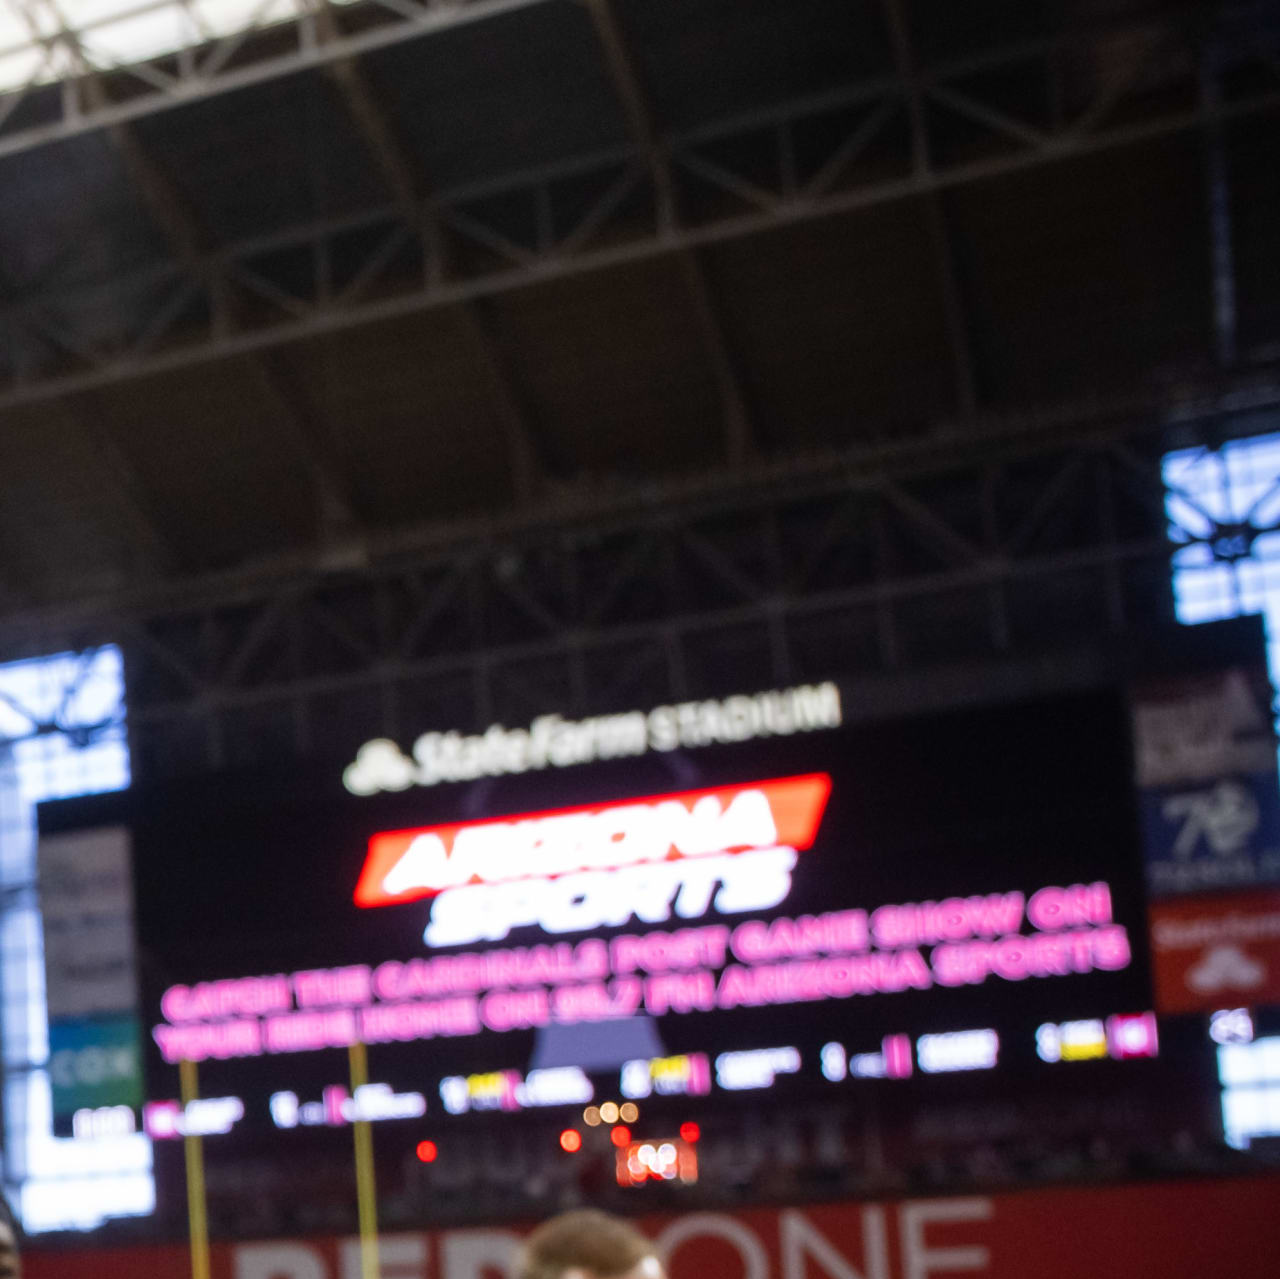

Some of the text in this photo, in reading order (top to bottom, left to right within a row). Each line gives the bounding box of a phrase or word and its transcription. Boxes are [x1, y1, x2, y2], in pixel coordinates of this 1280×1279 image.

[648, 681, 842, 752] STADIUM
[383, 789, 778, 896] ARIZONA
[372, 937, 608, 1000] CARDINALS
[609, 924, 730, 977] POST
[731, 908, 869, 964] GAME
[870, 890, 1026, 949] SHOW
[1027, 880, 1114, 932] ON
[423, 845, 798, 948] SPORTS
[717, 947, 933, 1010] ARIZONA
[931, 923, 1132, 987] SPORTS
